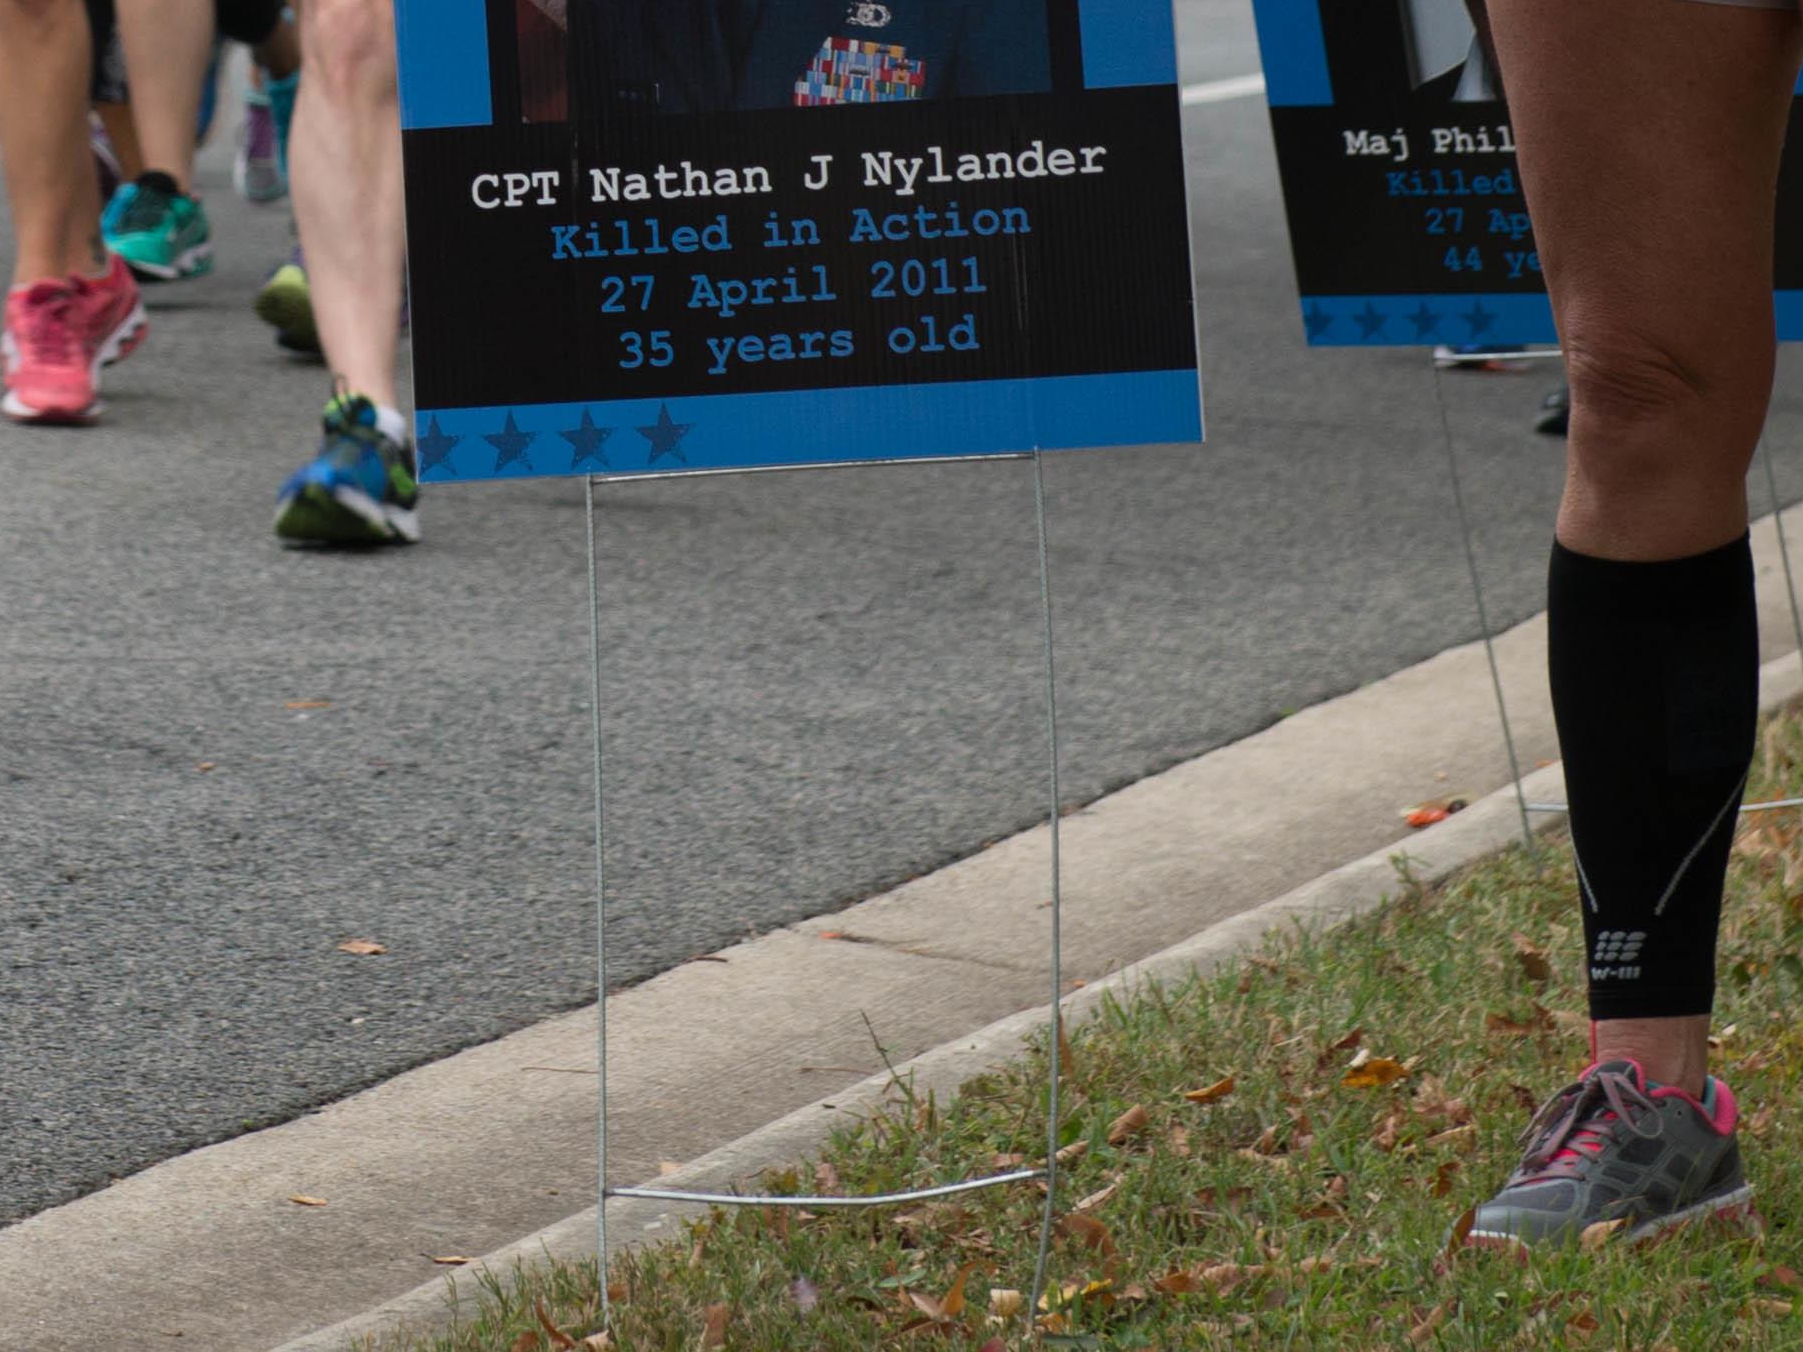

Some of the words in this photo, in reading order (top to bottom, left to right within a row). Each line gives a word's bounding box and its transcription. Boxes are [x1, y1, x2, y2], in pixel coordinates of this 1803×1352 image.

[1343, 128, 1410, 162] Maj
[1431, 125, 1516, 154] Phil
[471, 171, 560, 209] CPT
[590, 161, 773, 204] Nathan
[803, 154, 834, 191] J
[861, 140, 1107, 196] Nylander
[1386, 168, 1516, 197] Killed
[550, 214, 733, 260] Killed
[763, 211, 821, 249] in
[849, 201, 1031, 243] Action
[1425, 207, 1465, 235] 27
[1444, 246, 1484, 272] 44
[600, 276, 656, 314] 27
[687, 265, 837, 318] April
[870, 257, 987, 299] 2011
[619, 330, 675, 369] 35
[707, 326, 855, 375] years
[887, 314, 980, 355] old
